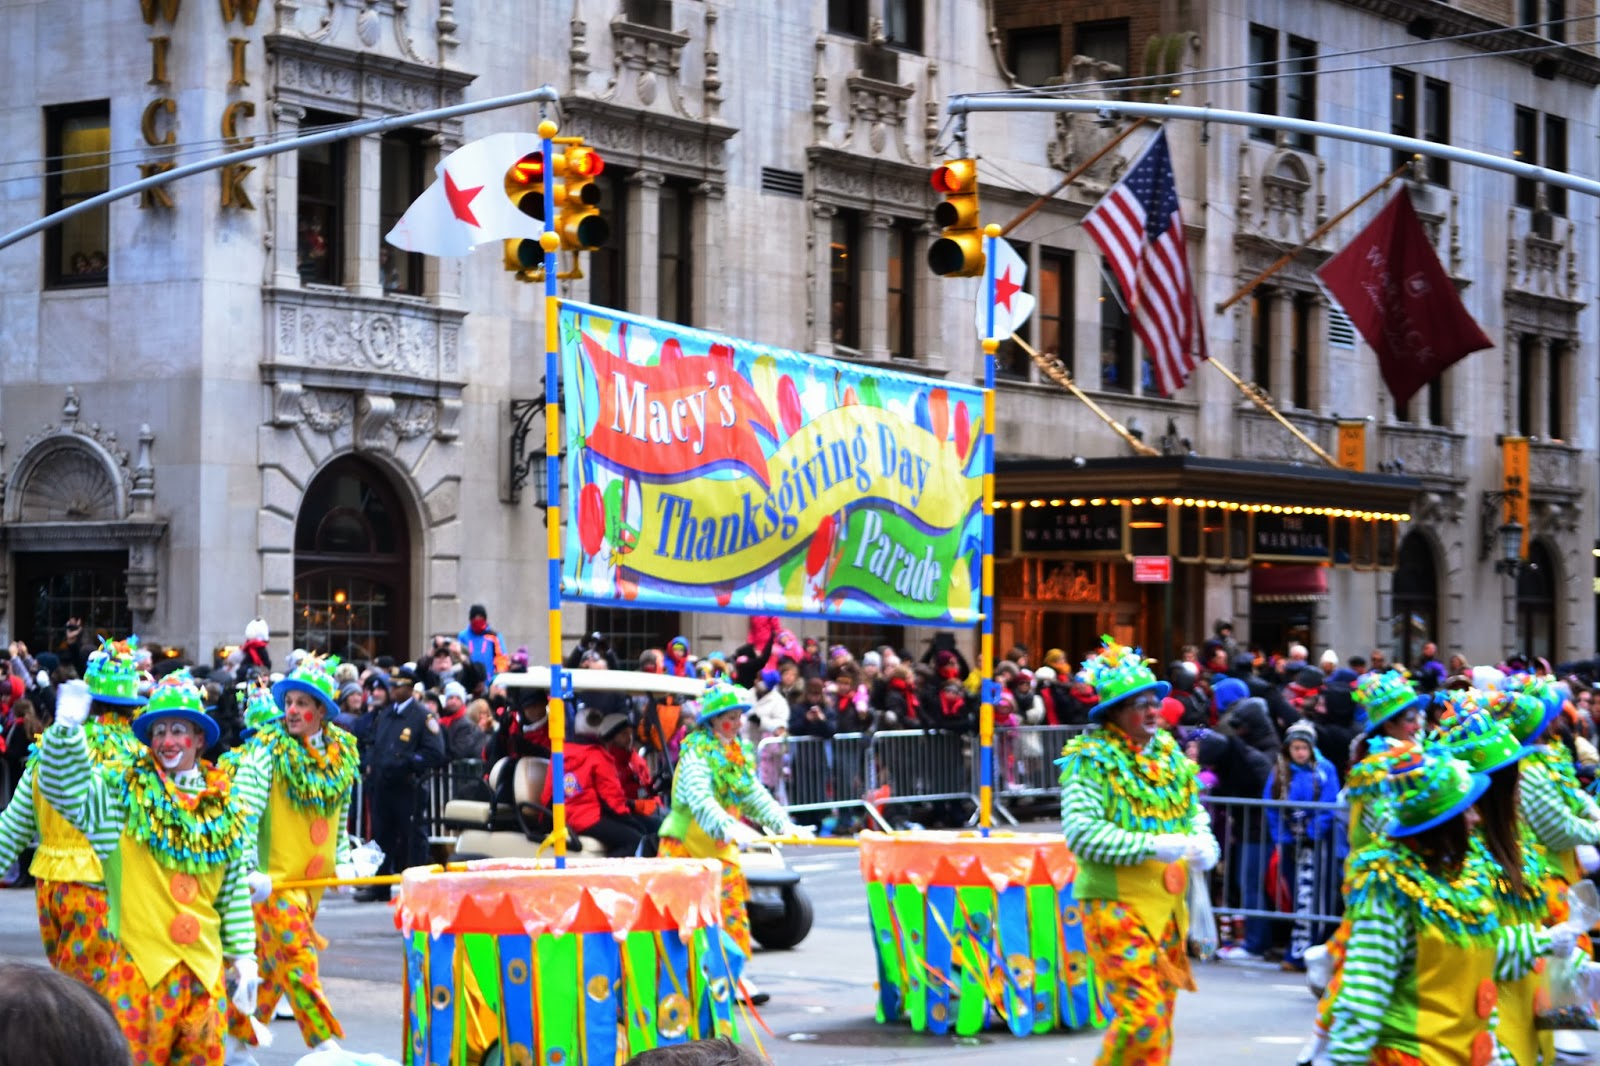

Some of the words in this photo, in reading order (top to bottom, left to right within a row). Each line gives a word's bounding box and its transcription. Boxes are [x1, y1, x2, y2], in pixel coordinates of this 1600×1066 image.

[611, 370, 737, 455] Macy's
[653, 425, 871, 563] Thanksgiving
[877, 421, 932, 508] Day
[1024, 527, 1118, 541] WARWICK
[852, 508, 942, 602] Parade
[1290, 847, 1314, 959] GIANTS
